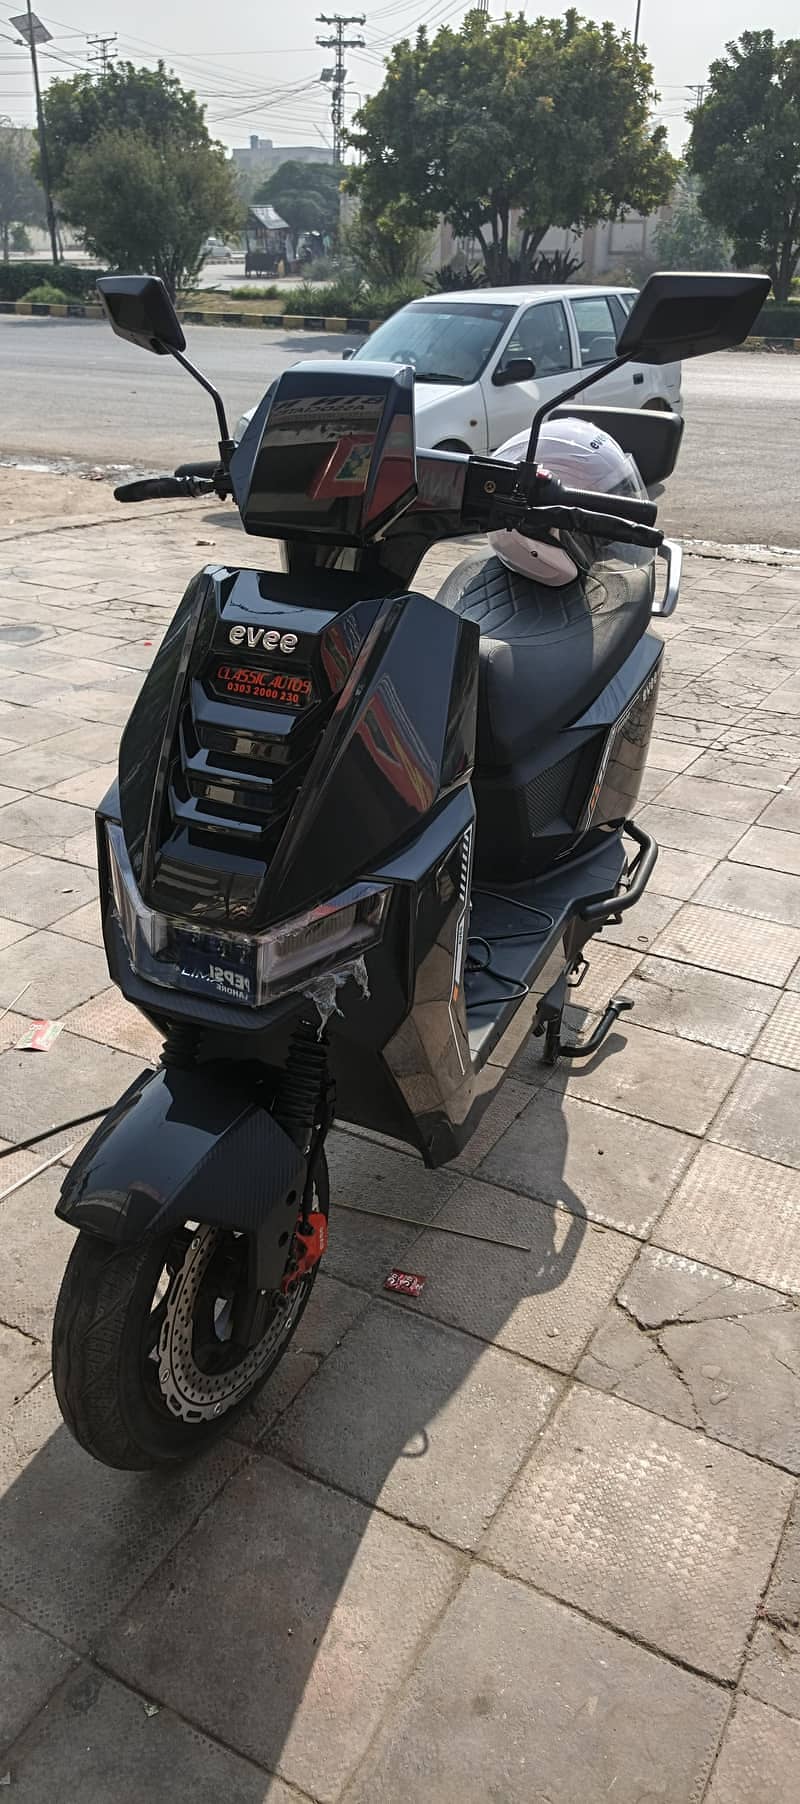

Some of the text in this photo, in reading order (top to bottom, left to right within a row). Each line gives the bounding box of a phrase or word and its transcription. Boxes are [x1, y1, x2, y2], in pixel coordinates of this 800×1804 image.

[229, 625, 298, 654] evee
[217, 665, 312, 697] CLASSIC AUTOS
[227, 682, 299, 704] 0303 2000 230
